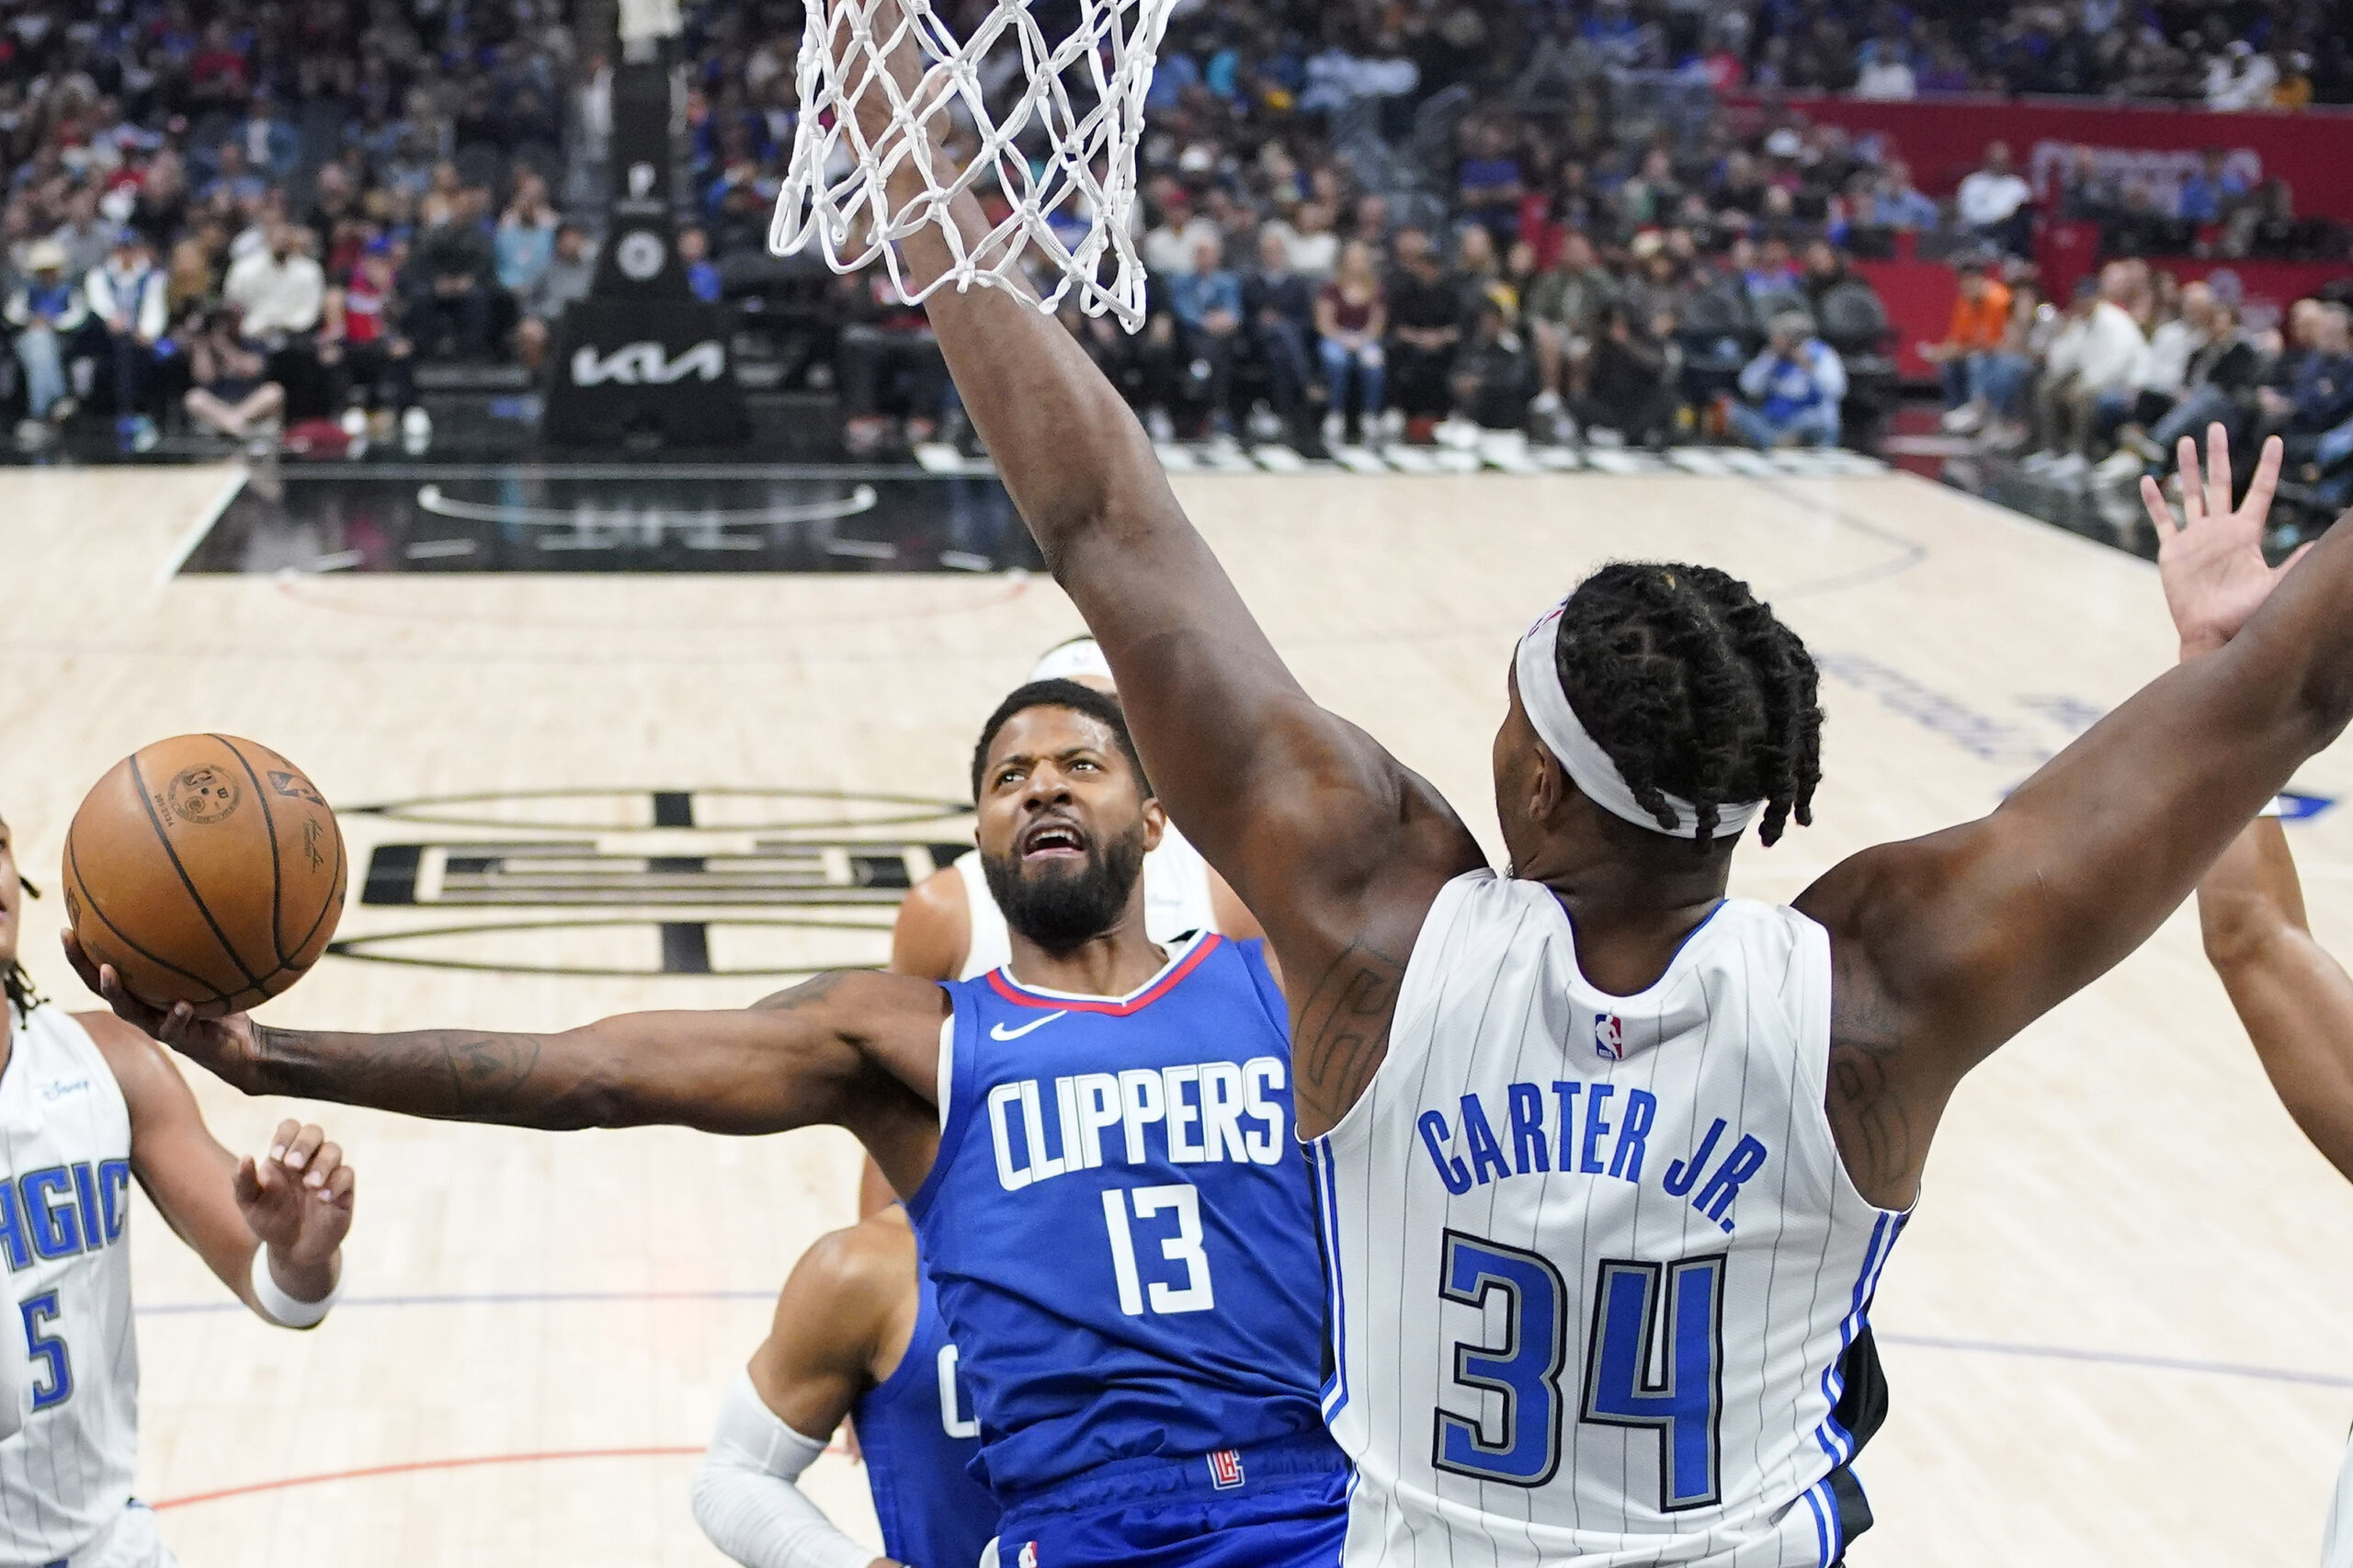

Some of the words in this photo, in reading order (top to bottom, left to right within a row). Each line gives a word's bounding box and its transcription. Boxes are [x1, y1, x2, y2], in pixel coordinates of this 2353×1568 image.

[987, 1056, 1285, 1192] CLIPPERS
[1417, 1081, 1657, 1196] CARTER
[1663, 1117, 1768, 1233] JR.
[1102, 1183, 1215, 1316] 13
[18, 1288, 74, 1414] 5
[1431, 1227, 1728, 1514] 34
